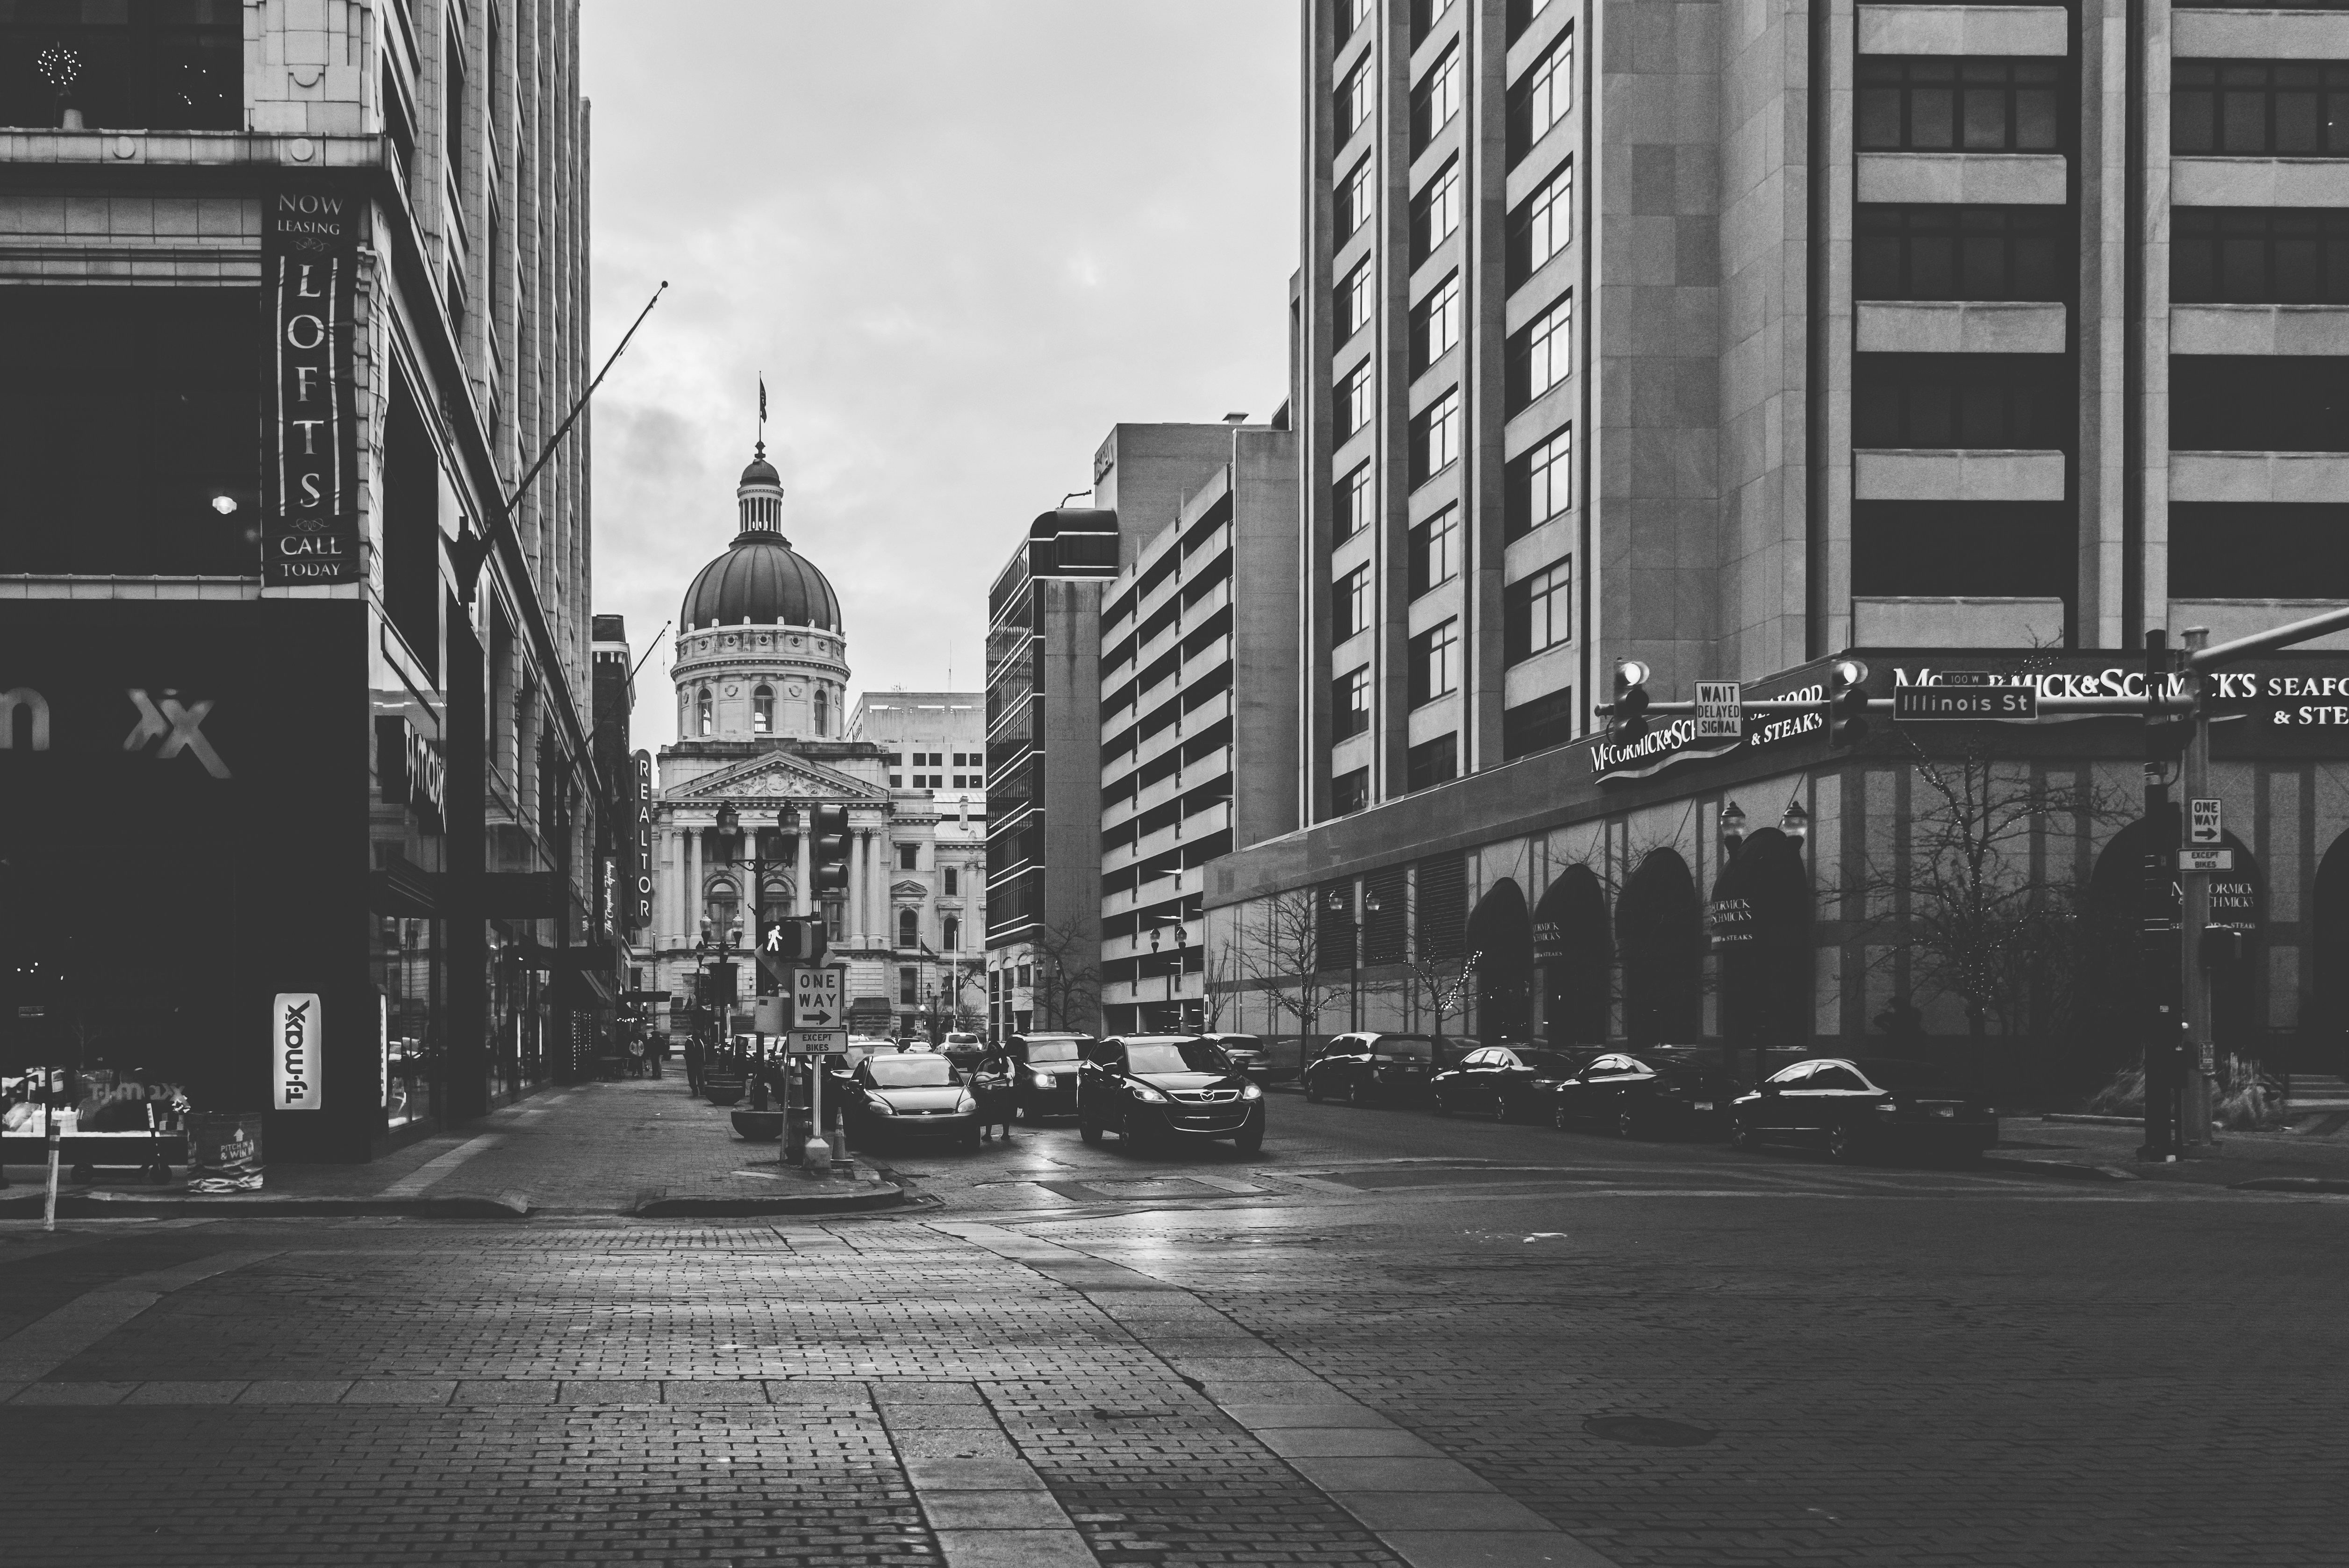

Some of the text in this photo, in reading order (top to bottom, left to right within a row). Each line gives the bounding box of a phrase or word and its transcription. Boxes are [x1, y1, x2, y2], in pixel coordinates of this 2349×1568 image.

[278, 194, 343, 216] NOW
[278, 219, 340, 236] LEASING
[287, 265, 324, 508] LOFTS
[280, 536, 342, 555] CALL
[280, 563, 341, 577] TODAY
[1951, 675, 1979, 684] 100 W
[1701, 686, 1735, 702] WAIT
[1904, 695, 2027, 711] Illinois St
[1698, 705, 1740, 718] DELAYED
[2273, 710, 2291, 724] &
[1702, 721, 1738, 734] SIGNAL
[1751, 712, 1823, 746] & STEAKS
[2194, 802, 2218, 813] ONE
[2194, 815, 2218, 825] WAY
[638, 759, 651, 916] REALTOR
[800, 974, 836, 988] ONE
[799, 994, 837, 1008] WAY
[802, 1034, 832, 1042] EXCEPT
[806, 1043, 829, 1051] BIKES
